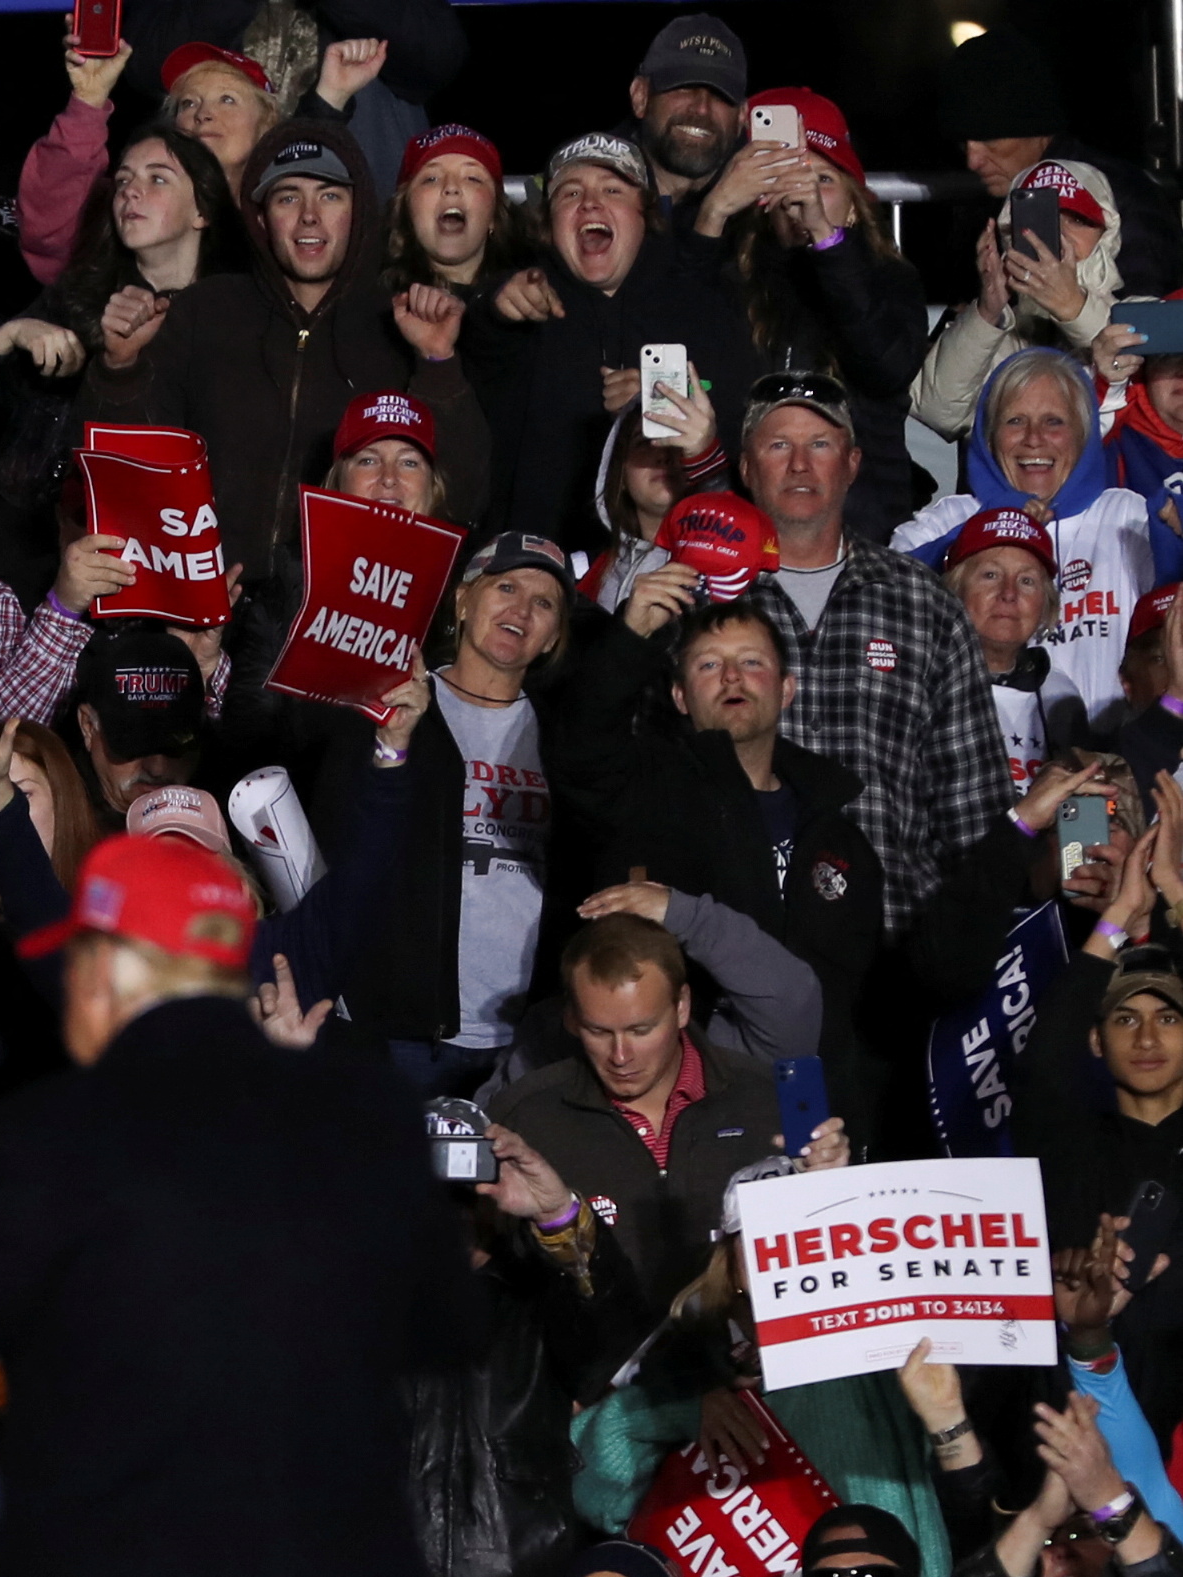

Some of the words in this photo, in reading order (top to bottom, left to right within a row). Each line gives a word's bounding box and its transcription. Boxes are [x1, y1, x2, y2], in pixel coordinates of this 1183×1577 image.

[680, 35, 708, 50] WEST
[559, 136, 630, 160] TRUMP
[377, 395, 409, 408] RUN
[363, 404, 422, 424] HERSCHEL
[375, 413, 410, 426] RUN
[678, 512, 747, 543] TRUMP
[997, 511, 1030, 524] RUN
[983, 519, 1041, 540] HERSCHEL
[995, 529, 1030, 540] RUN
[716, 545, 739, 557] GREAT
[1064, 561, 1086, 574] RUN
[349, 556, 413, 609] SAVE
[1064, 576, 1088, 589] RUN
[1058, 590, 1120, 625] HEL
[303, 606, 416, 672] AMERICA!
[869, 642, 894, 652] RUN
[871, 657, 895, 667] RUN
[115, 673, 190, 694] TRUMP
[463, 760, 546, 789] DRE
[961, 1016, 1013, 1129] SAVE
[754, 1213, 1040, 1273] HERSCHEL
[774, 1270, 849, 1299] FOR
[879, 1258, 1030, 1282] SENATE
[810, 1310, 859, 1332] TEXT
[863, 1302, 915, 1322] JOIN
[921, 1300, 947, 1315] TO
[953, 1300, 1005, 1316] 34134
